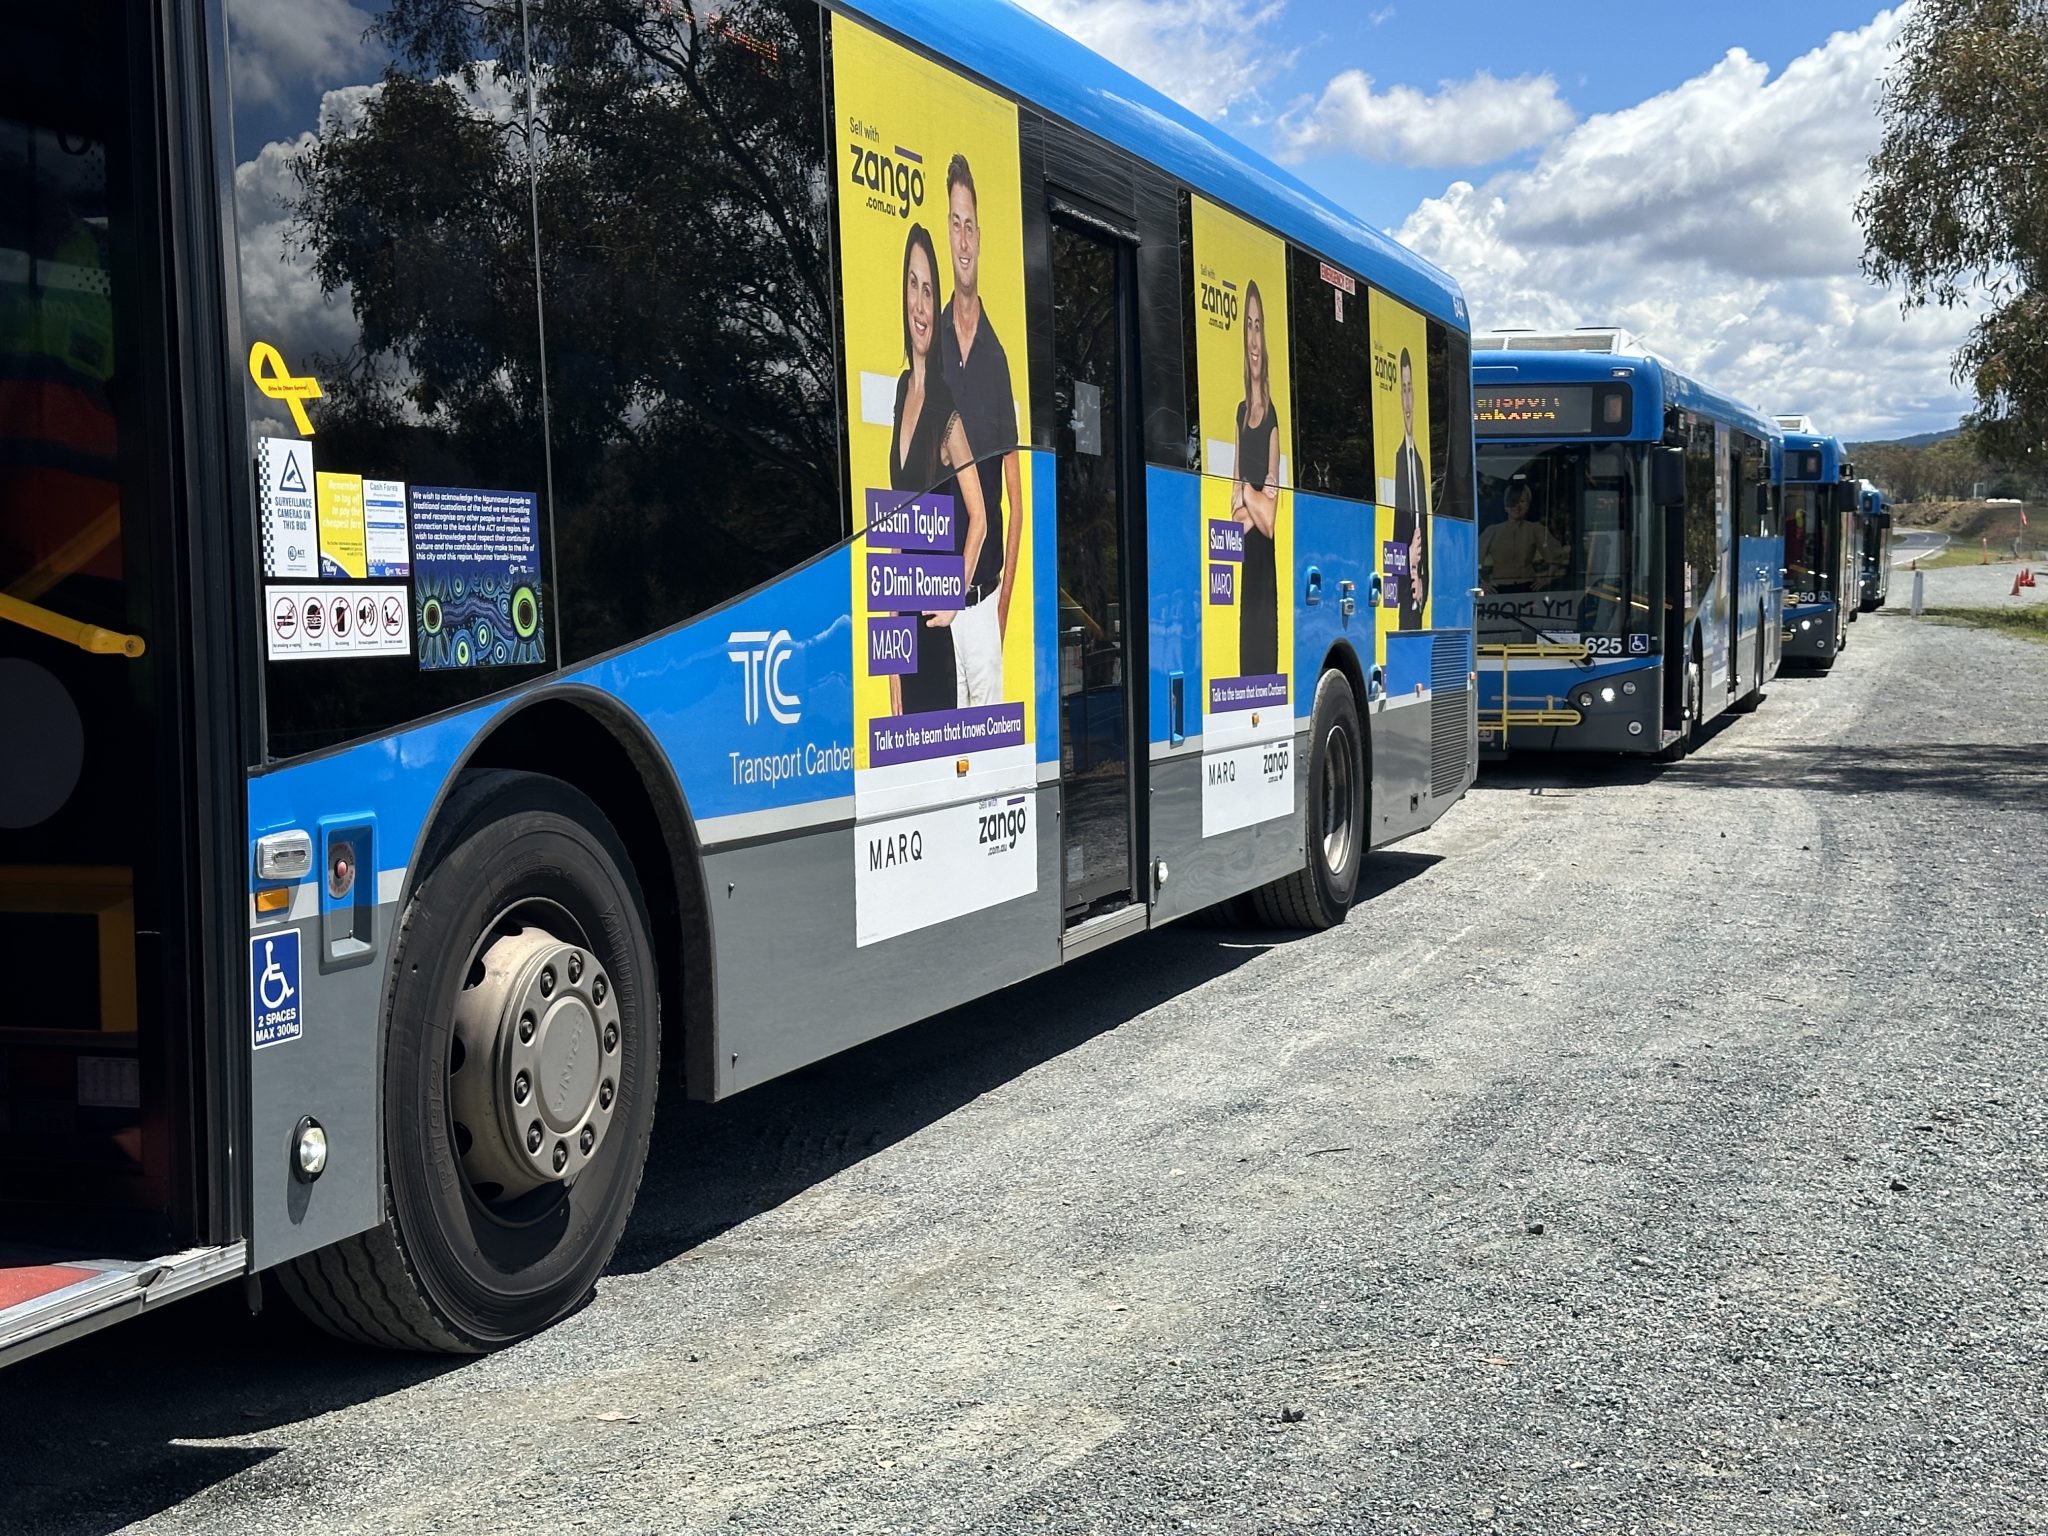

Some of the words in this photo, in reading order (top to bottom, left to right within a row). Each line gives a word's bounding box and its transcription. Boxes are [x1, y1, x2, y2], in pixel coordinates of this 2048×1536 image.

[849, 116, 862, 136] Sell
[864, 125, 879, 143] with
[850, 144, 924, 219] zango
[866, 196, 896, 216] .com.au
[1201, 282, 1237, 331] zango
[1375, 355, 1396, 391] zango
[370, 482, 383, 490] Cash
[384, 483, 398, 491] Fares
[275, 496, 312, 508] SURVEILLANCE
[278, 508, 302, 519] CAMERAS
[304, 510, 311, 519] ON
[283, 520, 295, 530] THIS
[296, 520, 306, 531] BUS
[871, 502, 909, 533] Justin
[912, 505, 950, 543] Taylor
[1210, 528, 1224, 550] Suzi
[1225, 529, 1242, 551] Wells
[871, 566, 881, 596] &
[884, 566, 912, 596] Dimi
[916, 567, 961, 597] Romero
[1211, 573, 1232, 598] MARQ
[872, 628, 913, 663] MARQ
[1585, 637, 1623, 654] 625
[728, 630, 801, 726] TC
[1212, 688, 1221, 702] Talk
[1222, 689, 1227, 702] to
[1235, 688, 1245, 700] team
[1246, 685, 1255, 699] that
[1255, 685, 1268, 698] knows
[1268, 683, 1286, 696] Canberra
[875, 731, 893, 751] Talk
[894, 732, 904, 747] to
[906, 727, 920, 747] the
[921, 728, 942, 744] team
[944, 723, 961, 742] that
[962, 721, 986, 739] knows
[986, 717, 1021, 736] Canberra
[729, 747, 801, 789] Transport
[1208, 760, 1235, 786] MARQ
[1263, 751, 1288, 780] zango
[979, 807, 1026, 849] zango
[869, 830, 923, 872] MARQ
[258, 1016, 264, 1028] 2
[266, 1007, 297, 1026] SPACES
[256, 1027, 275, 1042] MAX
[276, 1022, 299, 1037] 300kg
